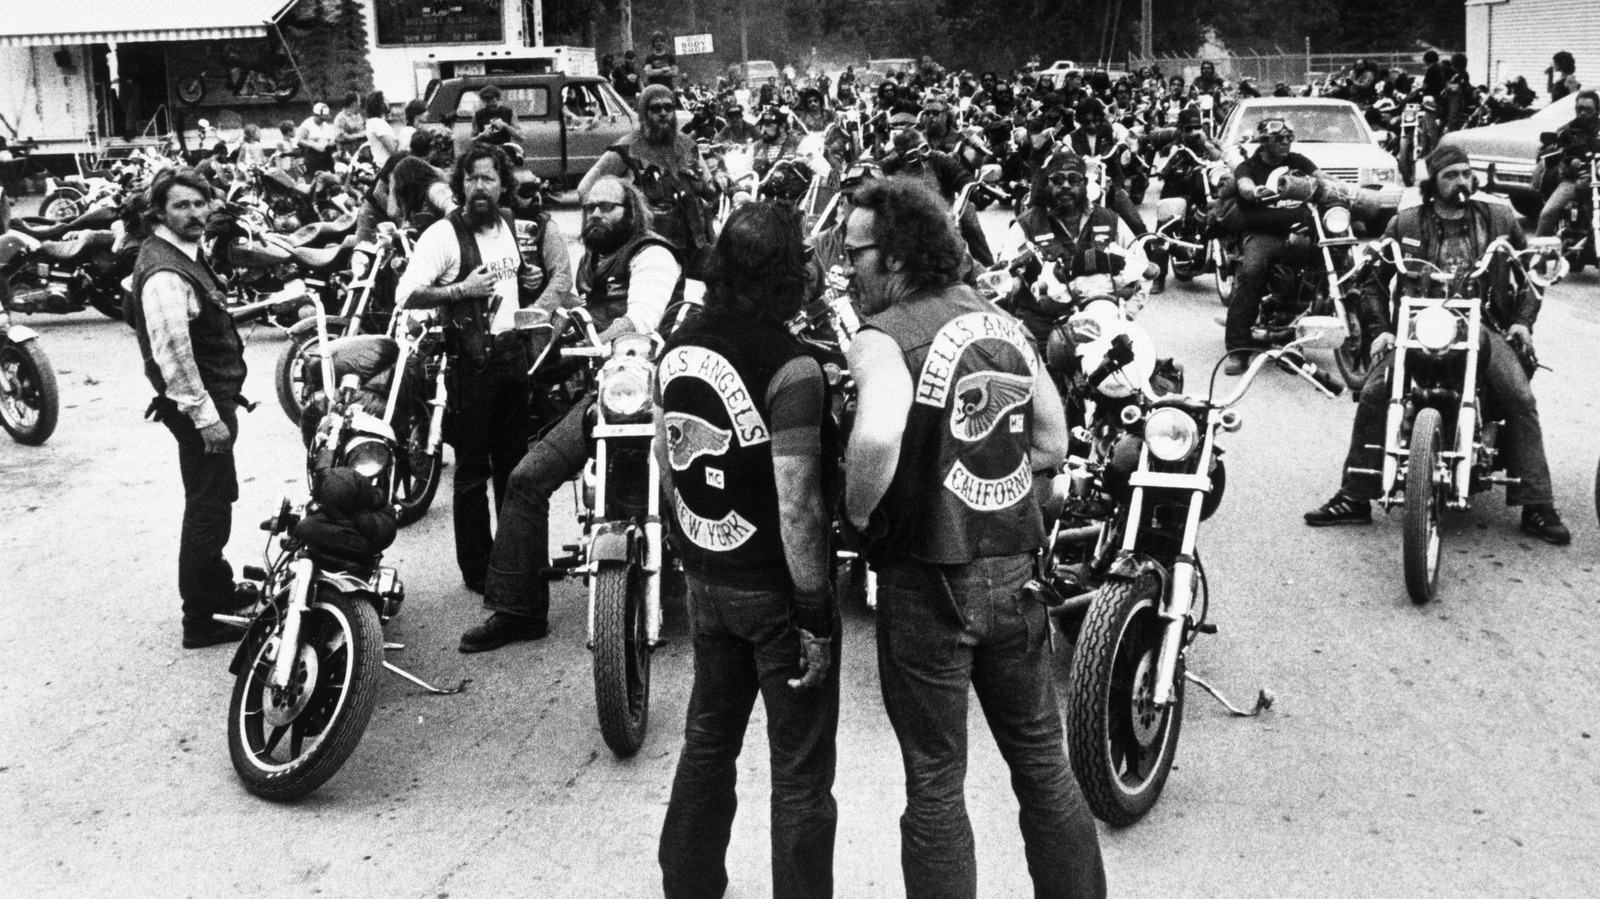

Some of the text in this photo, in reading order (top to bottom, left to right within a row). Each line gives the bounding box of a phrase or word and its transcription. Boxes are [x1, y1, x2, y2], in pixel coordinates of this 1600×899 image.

[919, 320, 974, 403] HELLS
[698, 354, 767, 442] ANGELS
[708, 471, 722, 485] MC
[675, 494, 750, 546] NEW YORK
